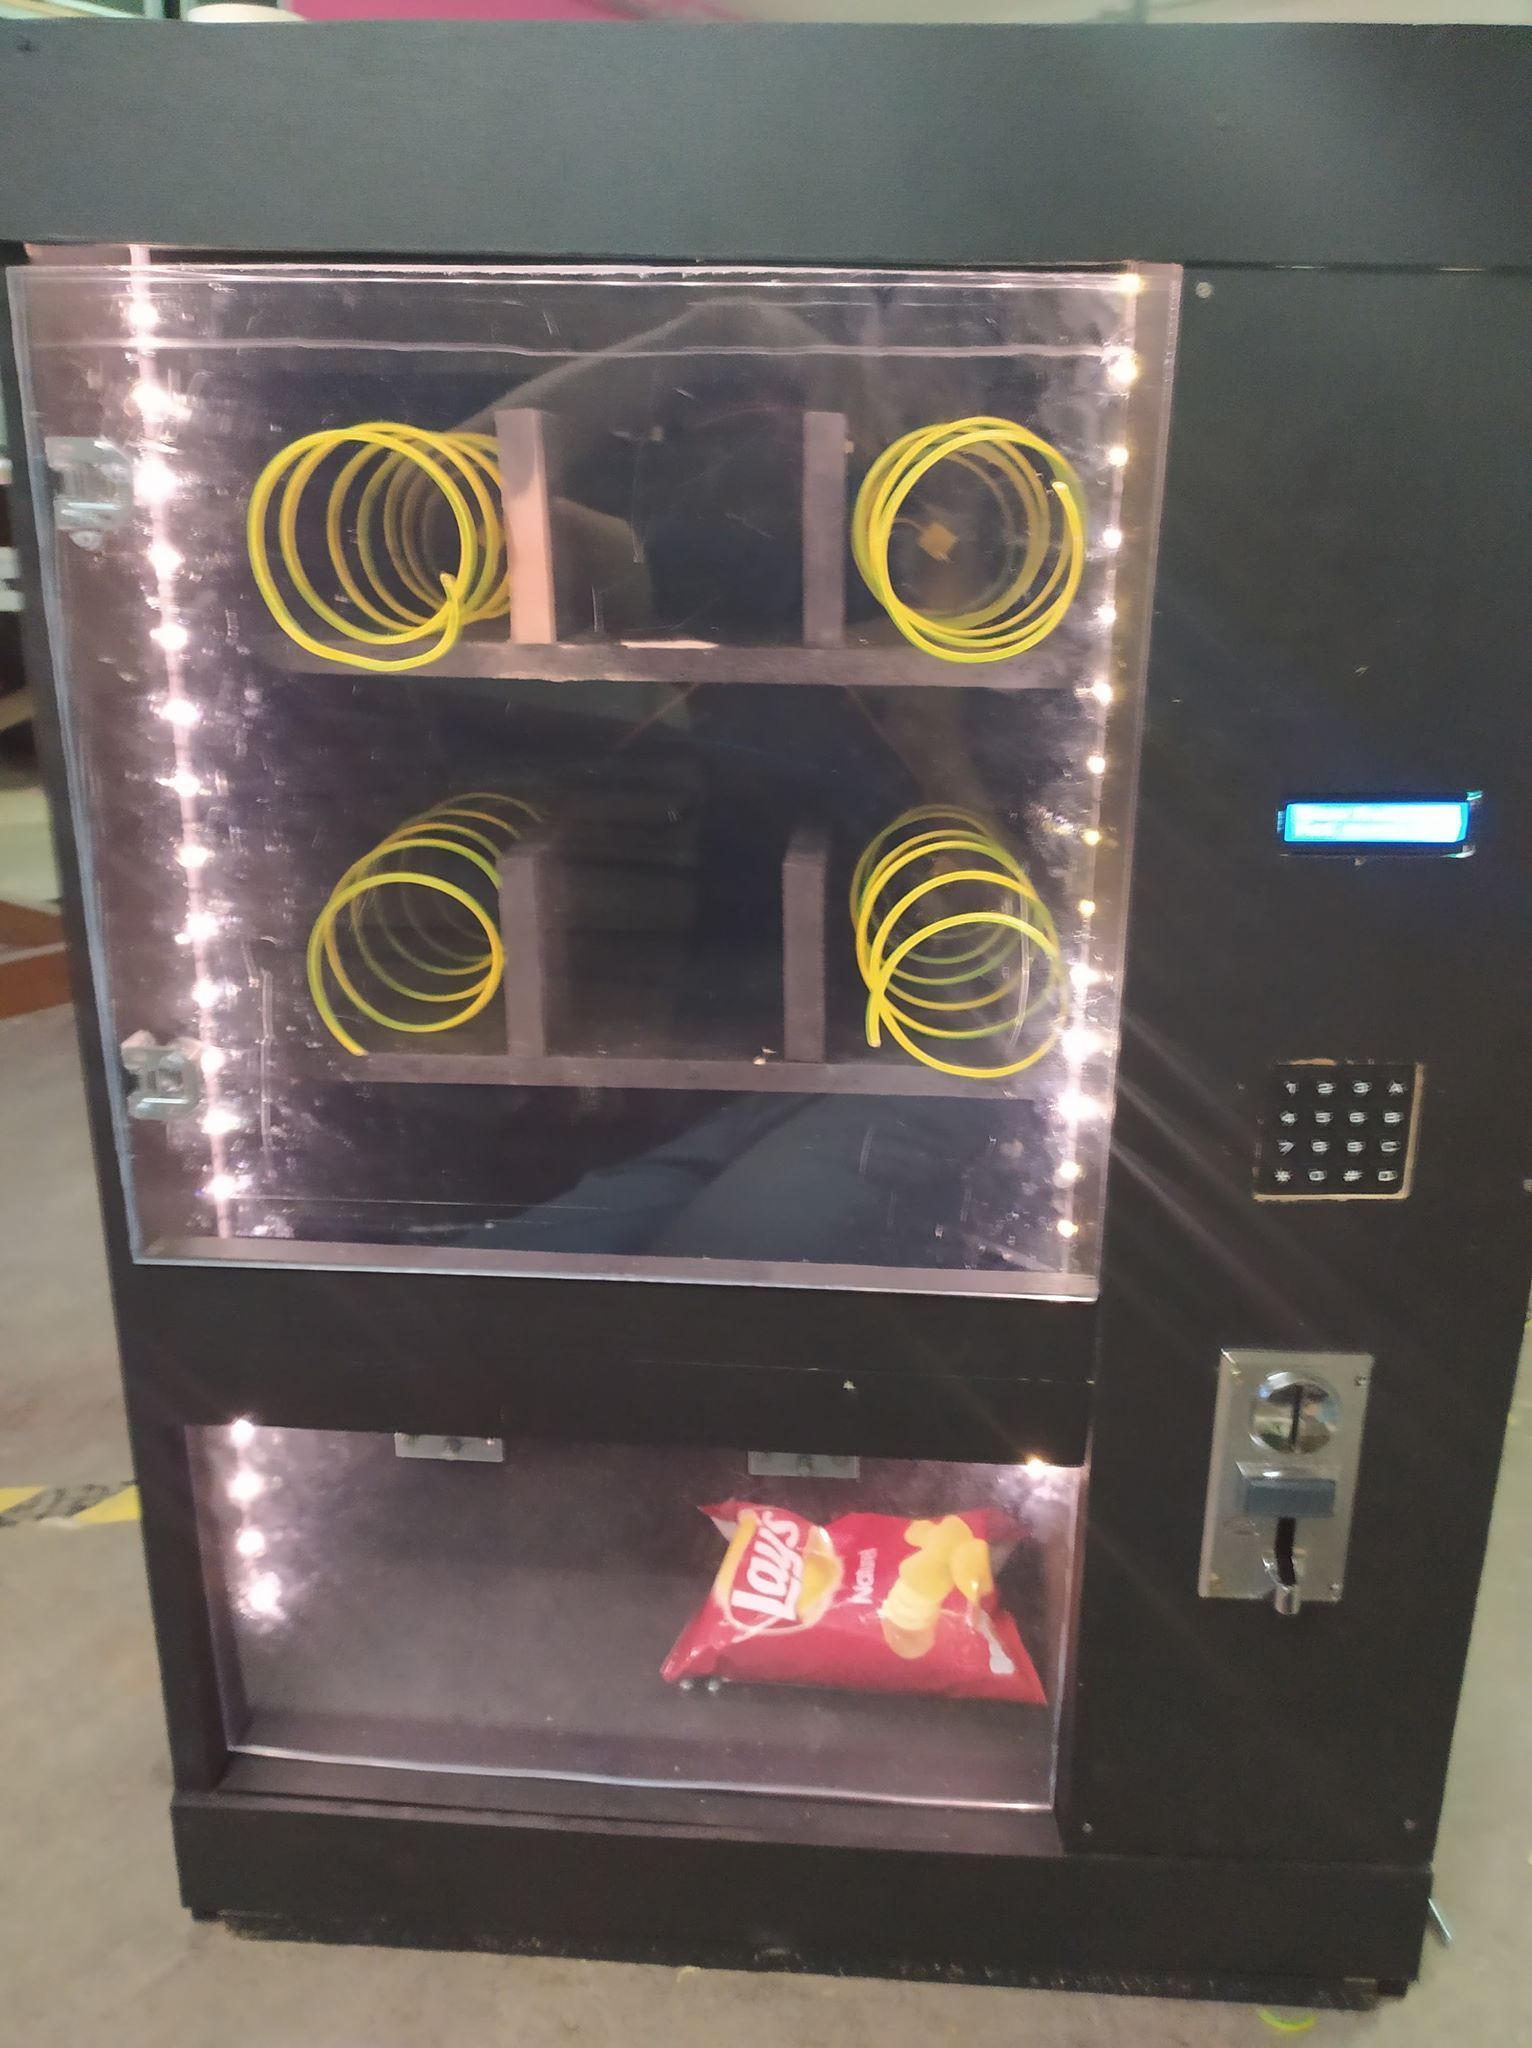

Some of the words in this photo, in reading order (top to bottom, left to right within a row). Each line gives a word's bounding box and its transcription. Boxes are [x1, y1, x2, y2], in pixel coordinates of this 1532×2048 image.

[1285, 1082, 1297, 1094] 1
[1317, 1082, 1335, 1094] 2
[1353, 1082, 1370, 1094] 3
[1388, 1082, 1404, 1094] A
[1280, 1112, 1296, 1124] 4
[1315, 1112, 1332, 1124] 5
[1278, 1141, 1295, 1154] 7
